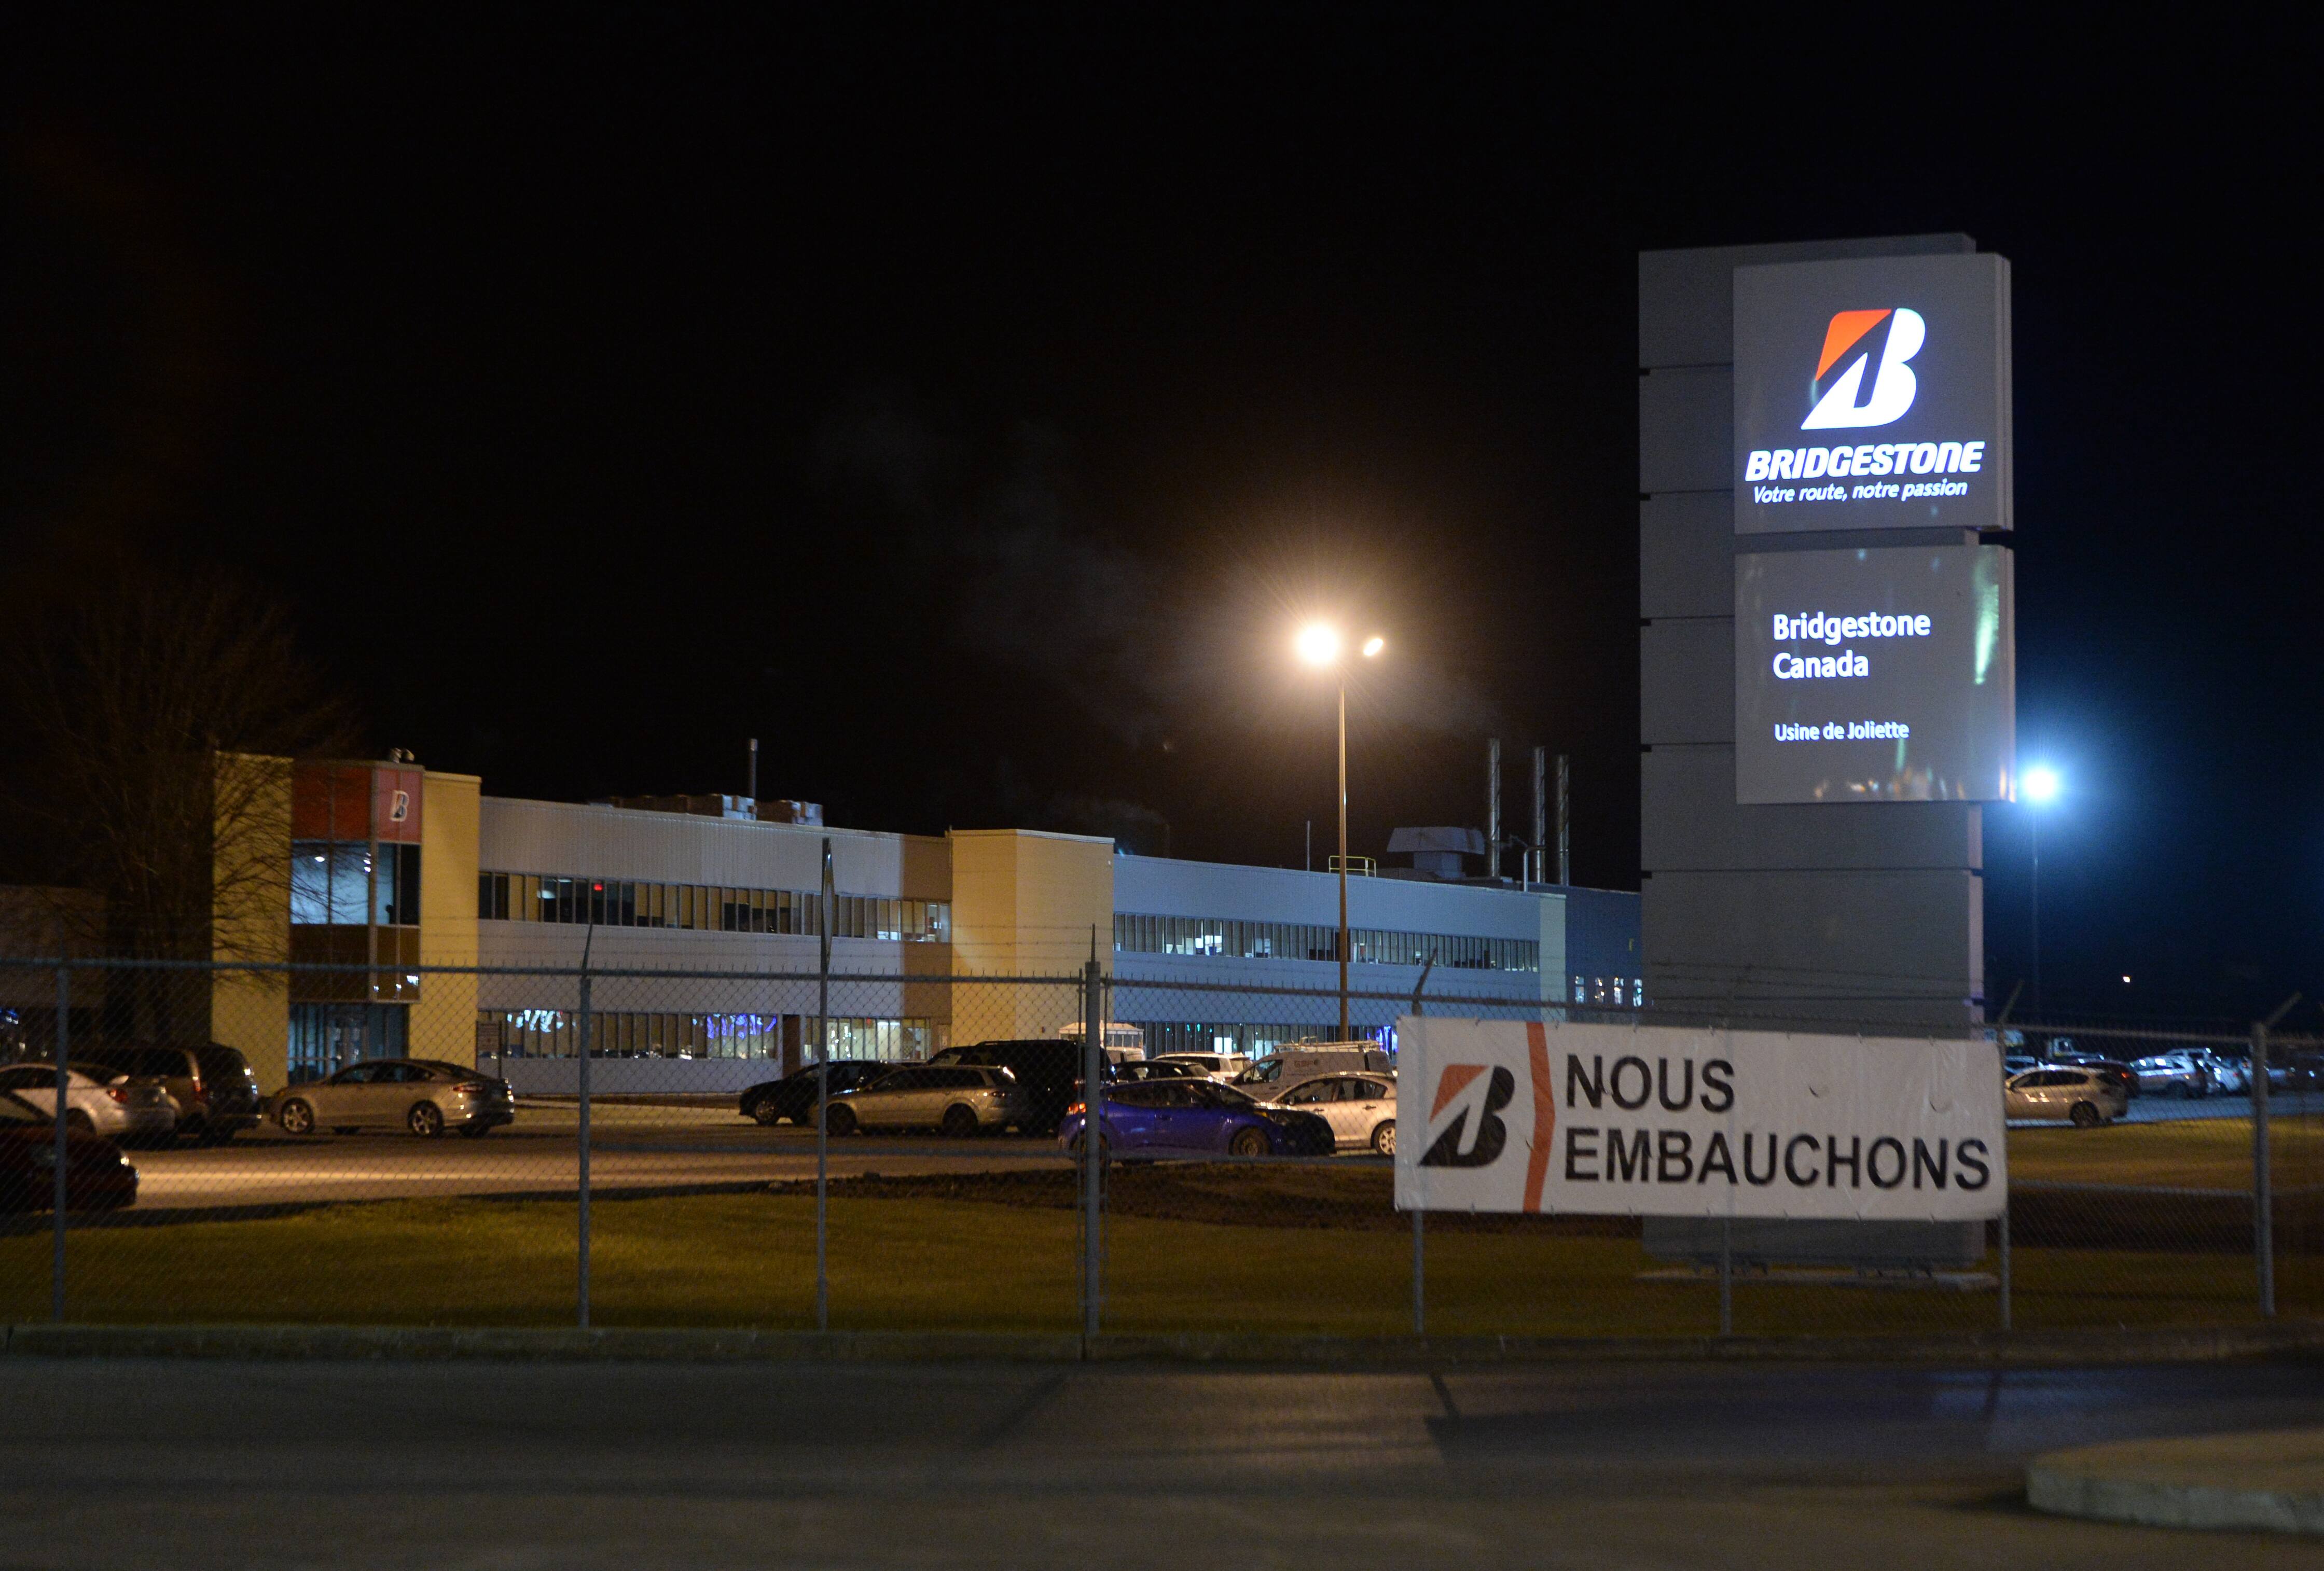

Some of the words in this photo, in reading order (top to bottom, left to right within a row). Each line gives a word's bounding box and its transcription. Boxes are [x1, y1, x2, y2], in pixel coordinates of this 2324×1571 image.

[1745, 441, 1985, 481] BRIDGESTONE
[1754, 485, 1795, 503] Votre
[1799, 483, 1848, 502] route,
[1852, 481, 1900, 499] notre
[1901, 478, 1968, 502] passion
[1774, 611, 1931, 645] Bridgestone
[1773, 649, 1869, 679] Canada
[1775, 722, 1820, 741] Usine
[1822, 721, 1845, 740] de
[1847, 720, 1910, 740] Joliette
[1566, 1054, 1735, 1114] NOUS
[1565, 1128, 1990, 1191] EMBAUCHONS
